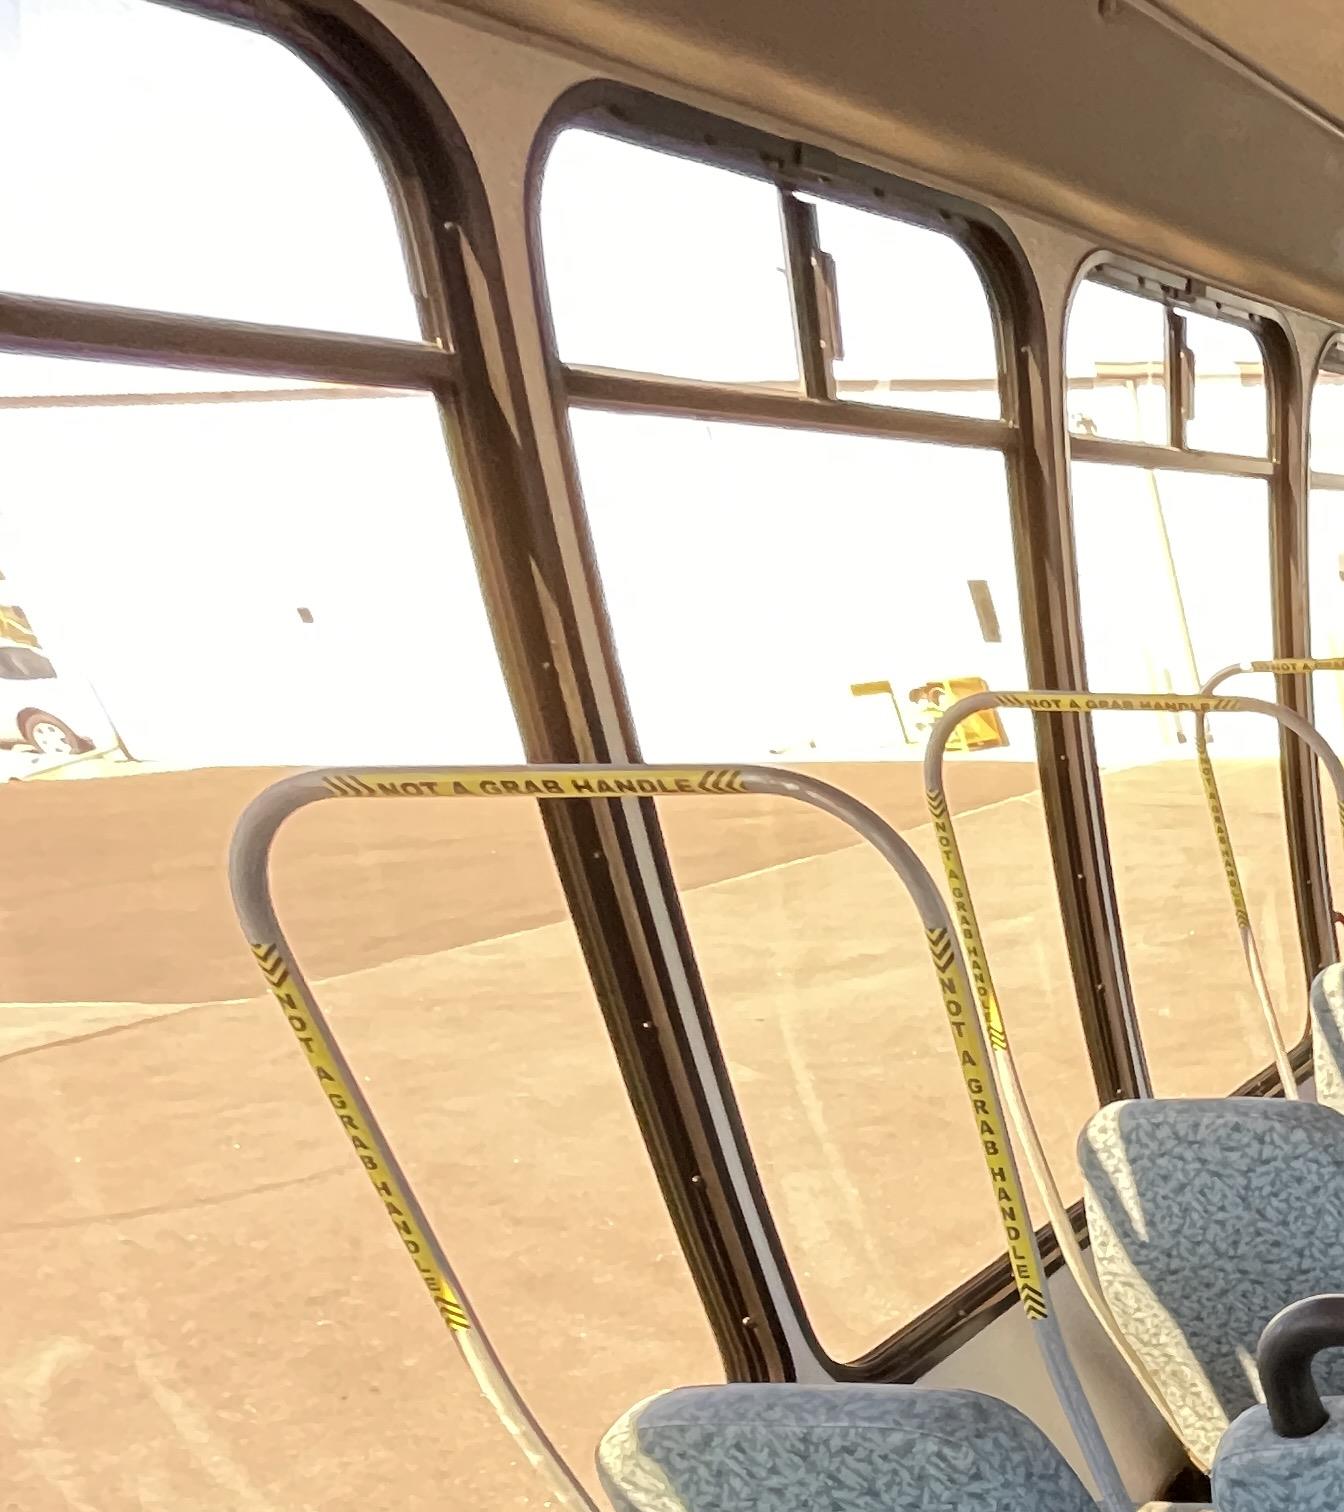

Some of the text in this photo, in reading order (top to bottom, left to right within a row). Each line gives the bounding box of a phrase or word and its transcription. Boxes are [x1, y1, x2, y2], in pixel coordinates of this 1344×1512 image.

[1024, 698, 1062, 710] NOT
[1069, 699, 1081, 710] A
[375, 777, 696, 797] NOT A GRAB HANDLE
[934, 821, 951, 862] NOT
[948, 868, 958, 881] A
[951, 887, 973, 940] GRAB
[275, 992, 442, 1292] NOT A GRAB HANDLE
[941, 977, 1031, 1280] NOT A GRAB HANDLE
